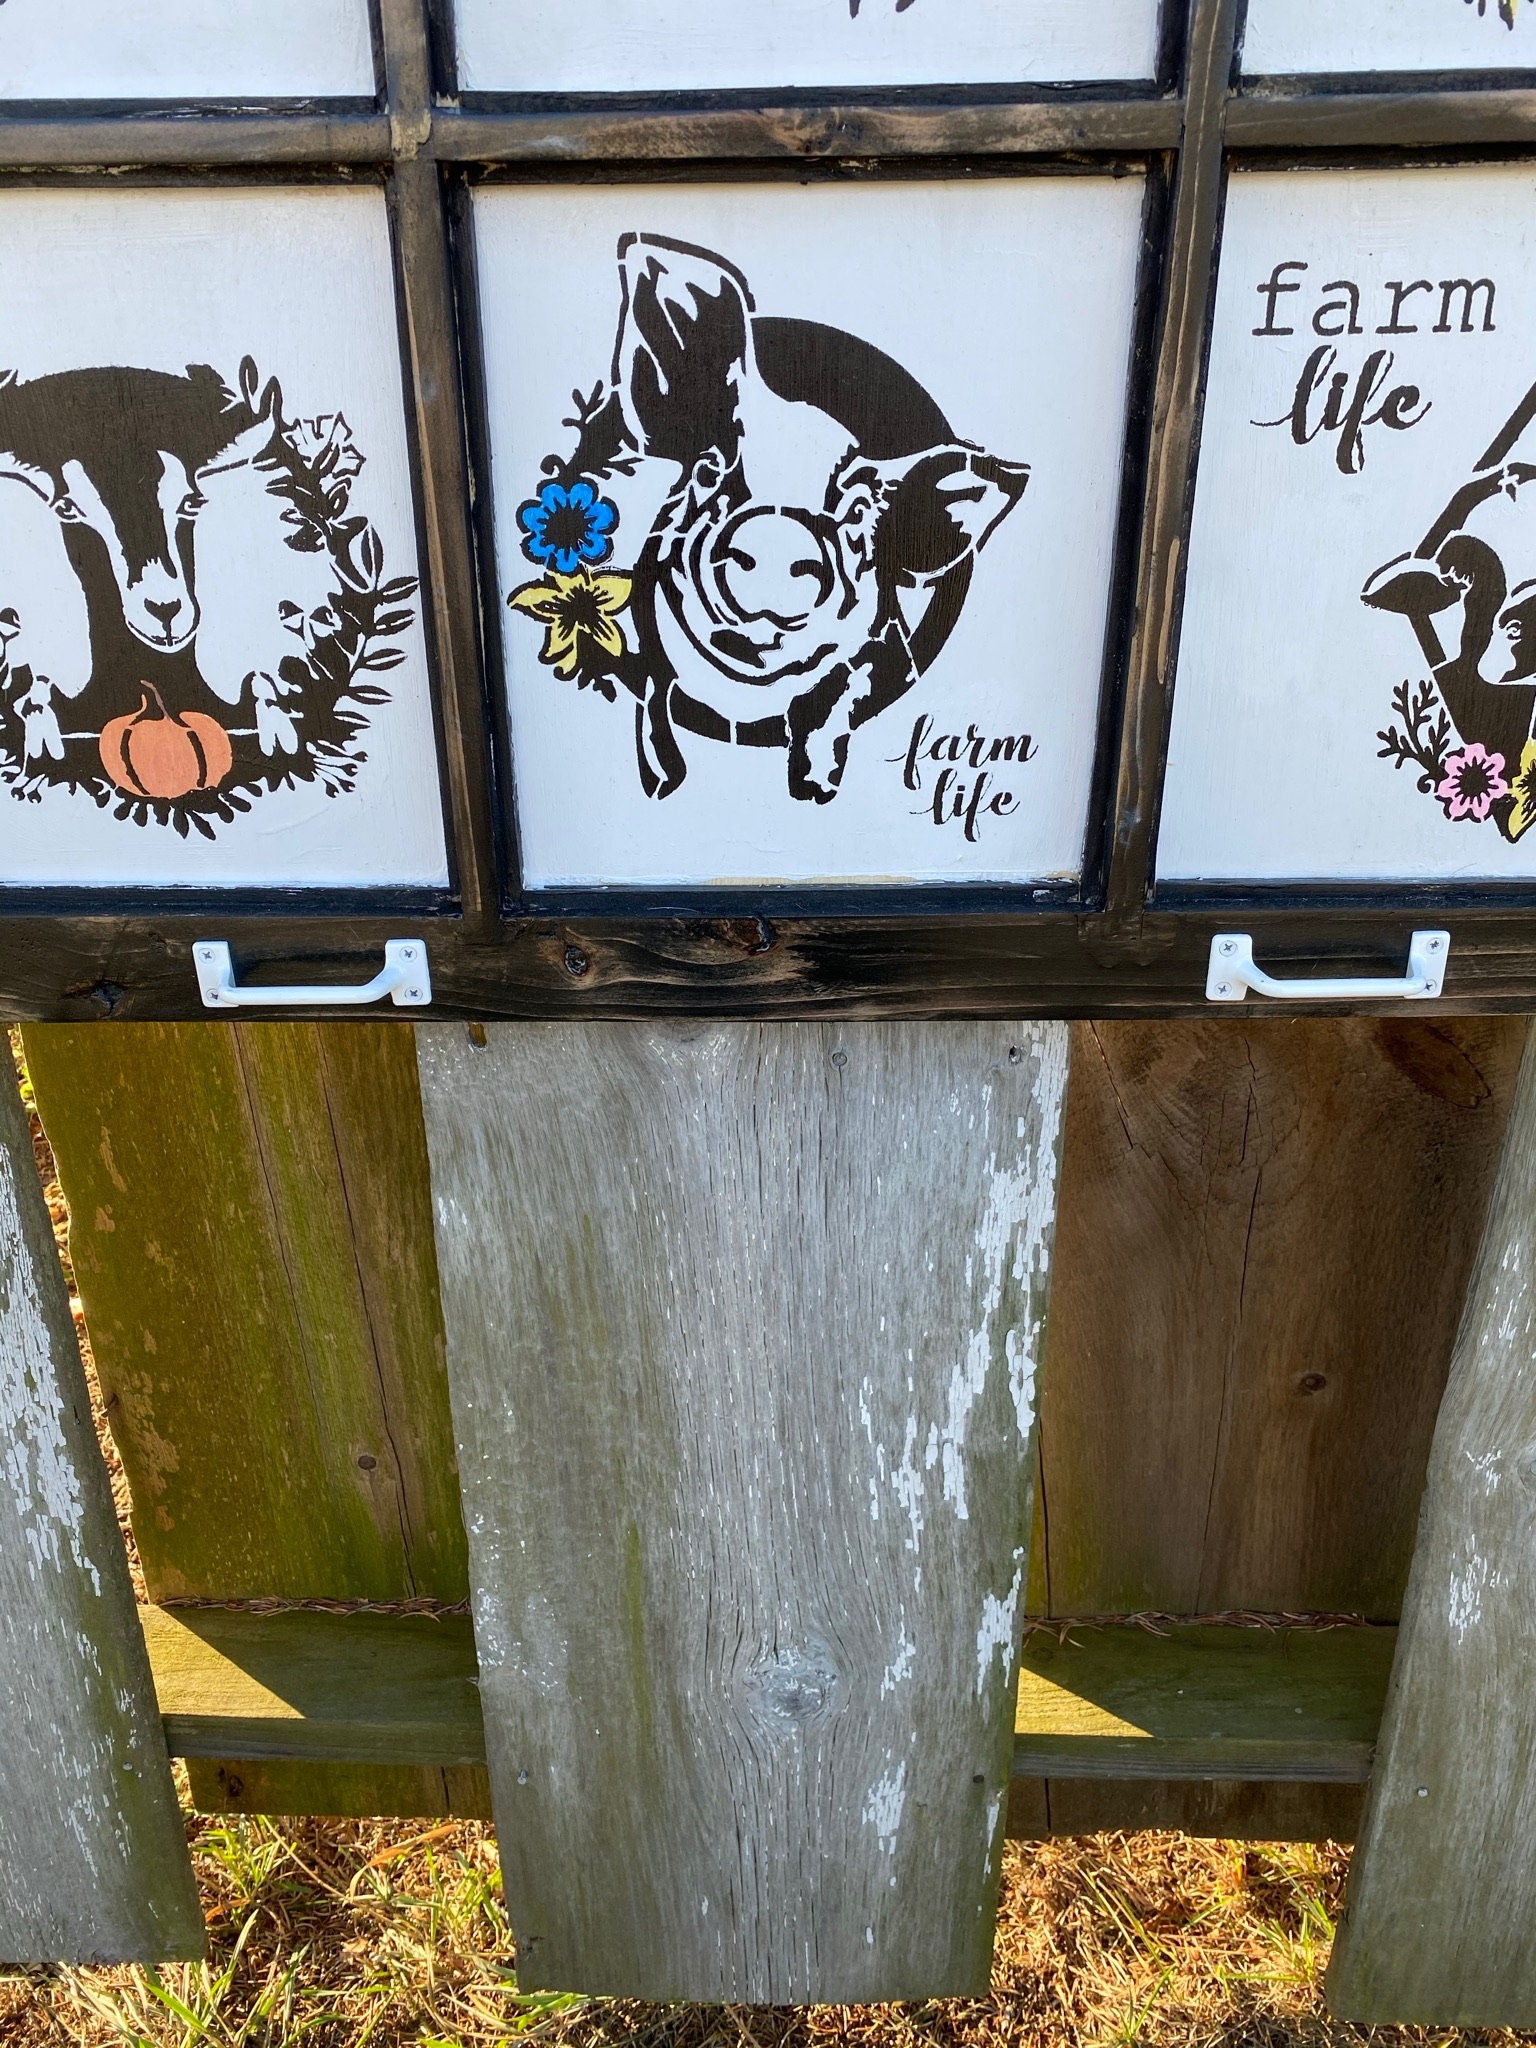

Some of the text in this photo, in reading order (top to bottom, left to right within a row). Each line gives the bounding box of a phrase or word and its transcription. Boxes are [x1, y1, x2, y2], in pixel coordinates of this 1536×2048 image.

[1251, 261, 1496, 337] farm
[1250, 344, 1433, 475] life
[884, 713, 1039, 791] farm
[909, 768, 1021, 843] life
